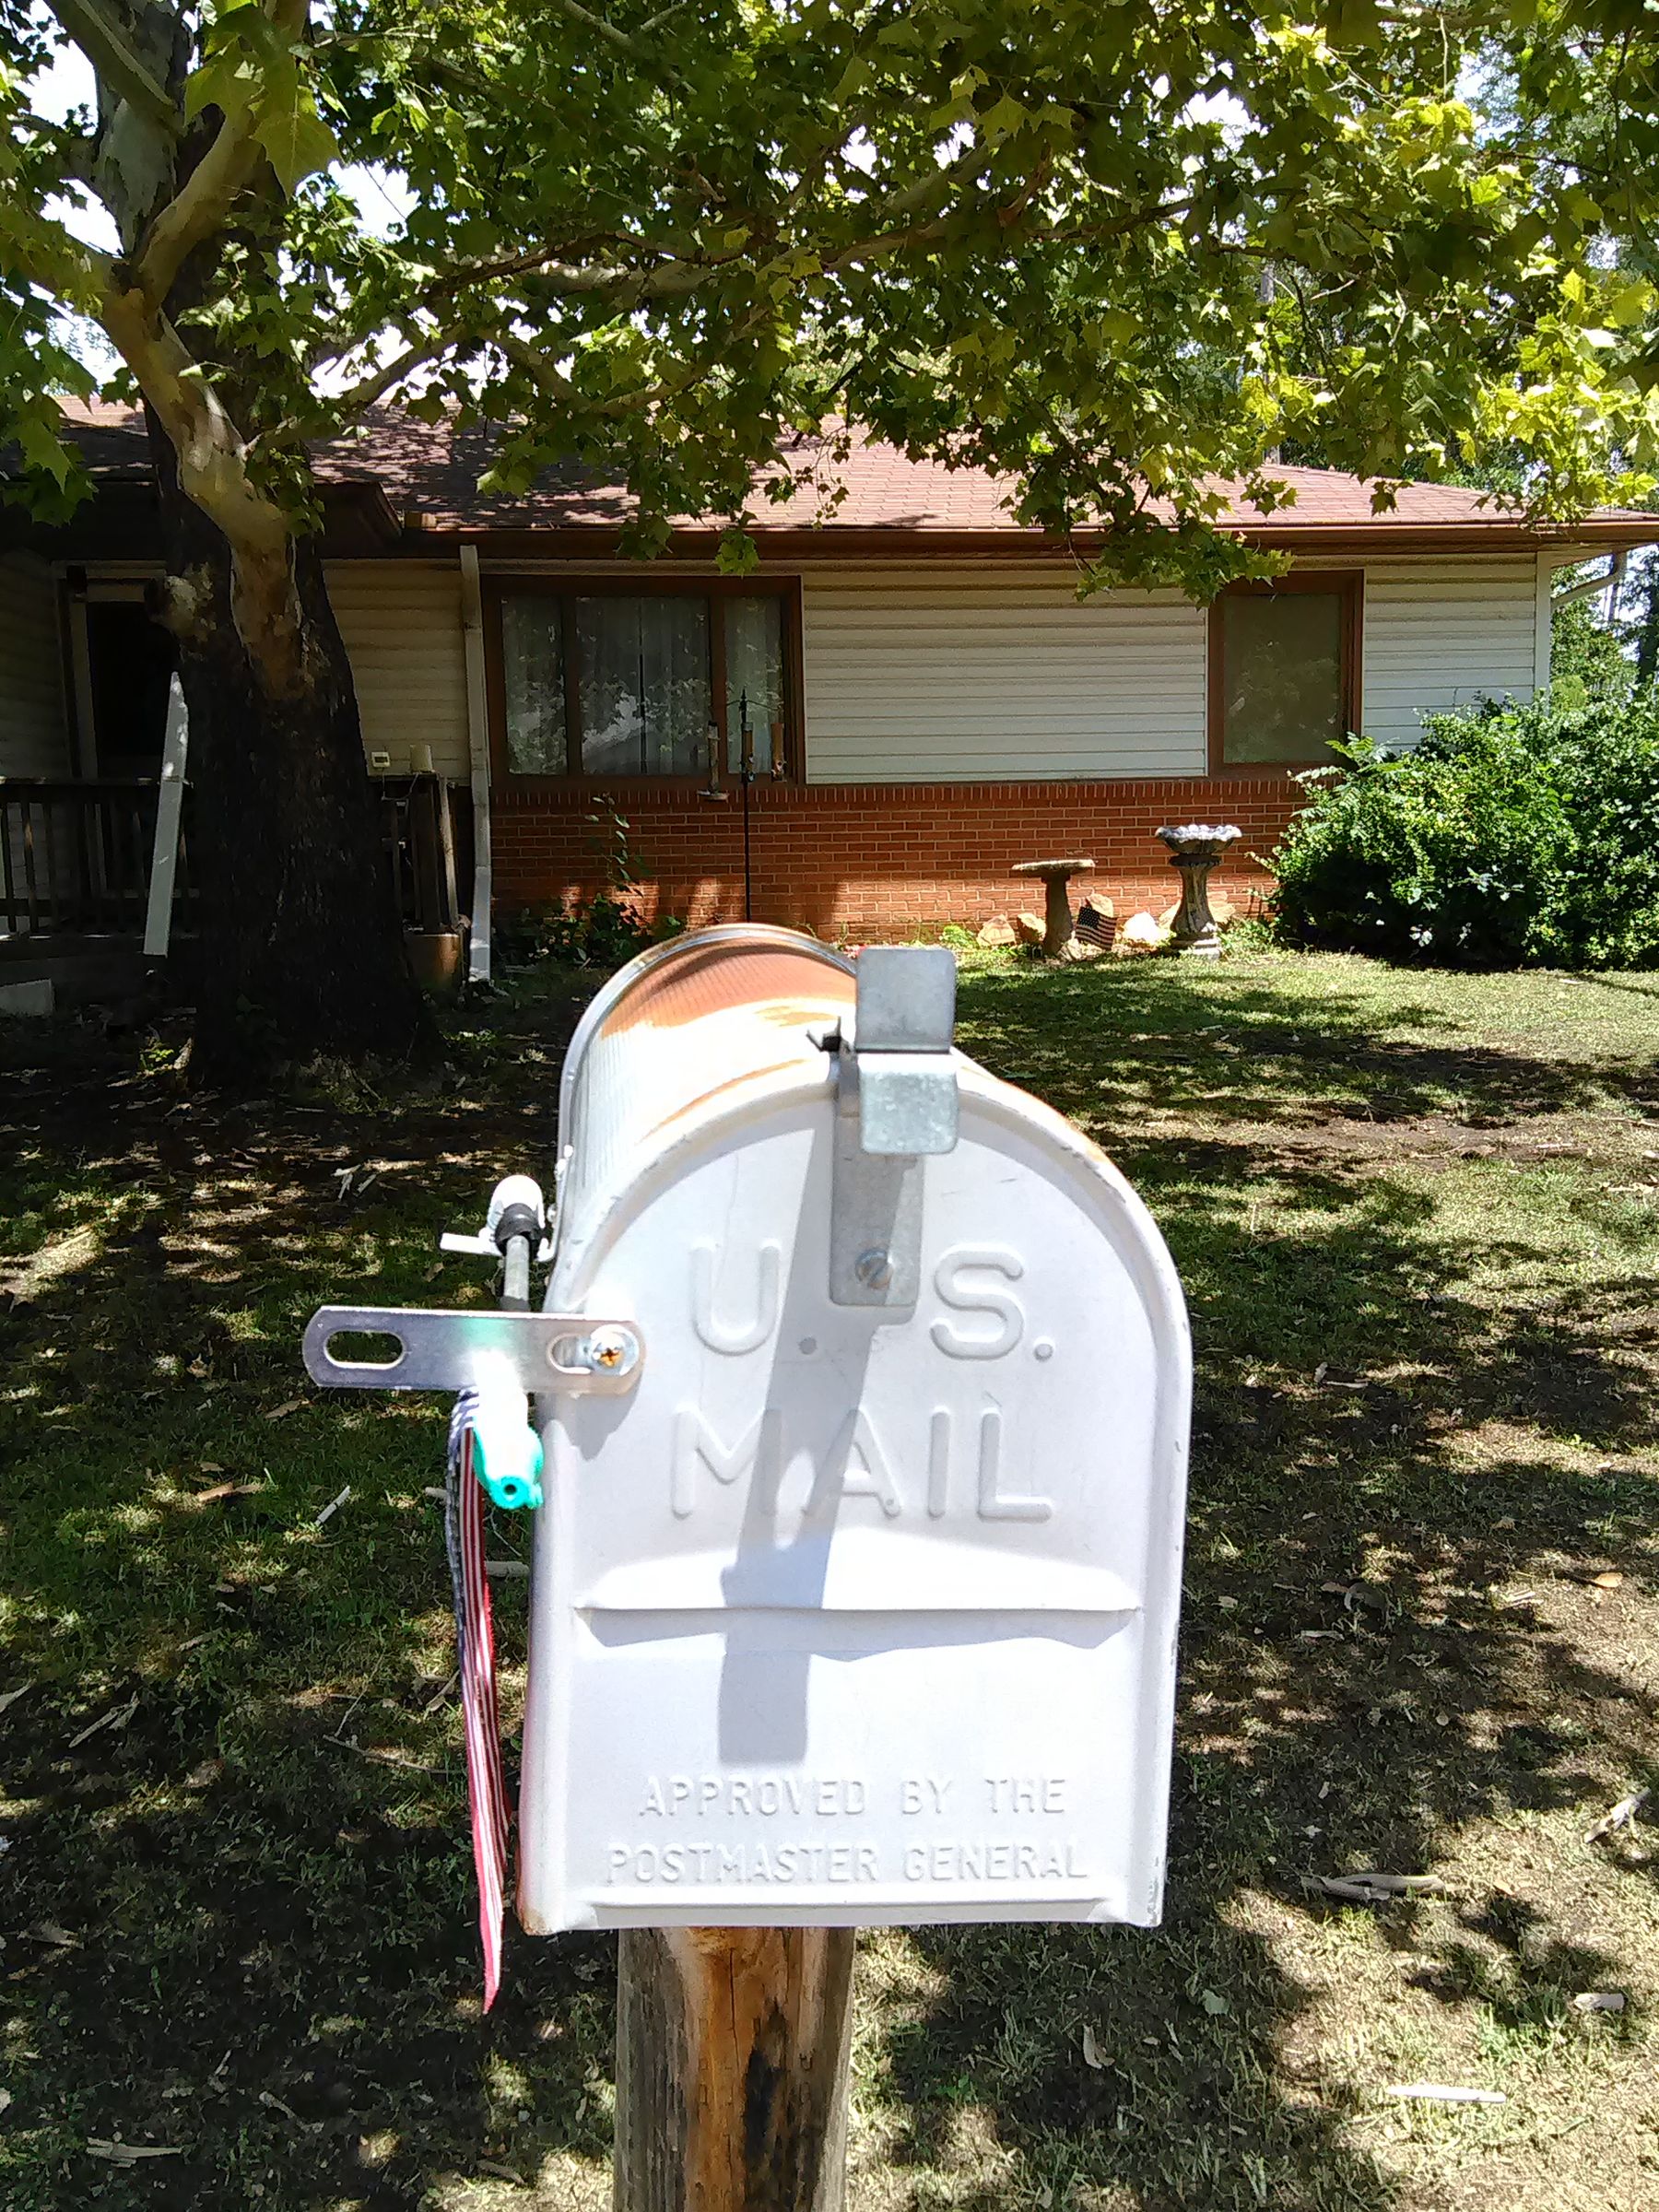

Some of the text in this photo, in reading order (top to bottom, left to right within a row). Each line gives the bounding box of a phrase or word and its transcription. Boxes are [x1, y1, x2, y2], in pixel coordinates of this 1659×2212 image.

[671, 1403, 1053, 1523] MAIL
[639, 1775, 1066, 1817] APPROVED BY THE
[606, 1841, 1089, 1883] POSTMASTER GENERAL
